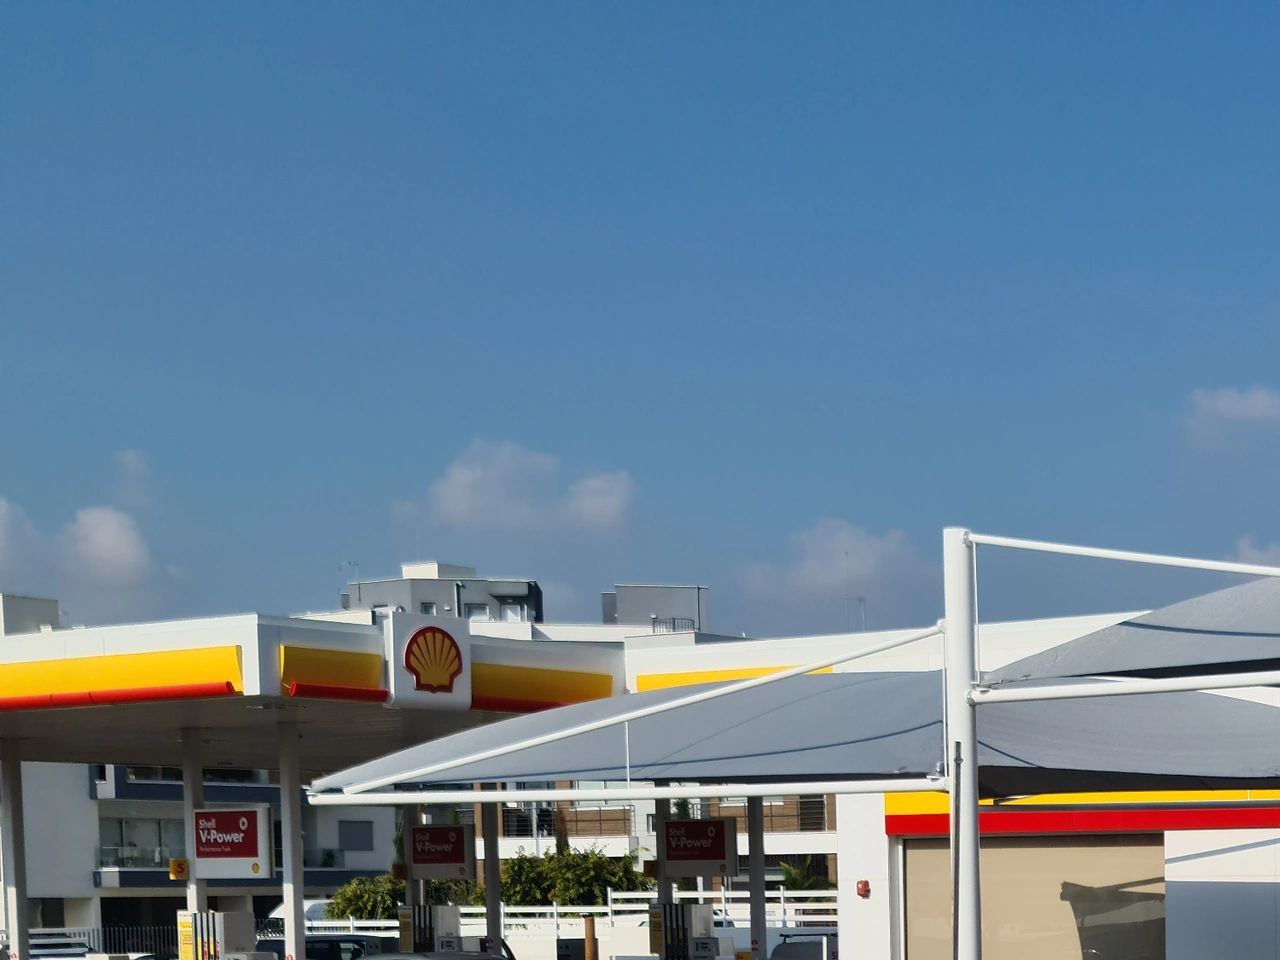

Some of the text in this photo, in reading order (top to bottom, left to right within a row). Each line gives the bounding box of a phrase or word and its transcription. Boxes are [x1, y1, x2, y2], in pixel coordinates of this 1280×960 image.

[199, 818, 216, 829] Shell
[200, 830, 244, 843] V-Power
[416, 842, 453, 852] V-Power
[670, 837, 712, 848] V-Power
[177, 863, 184, 874] 5
